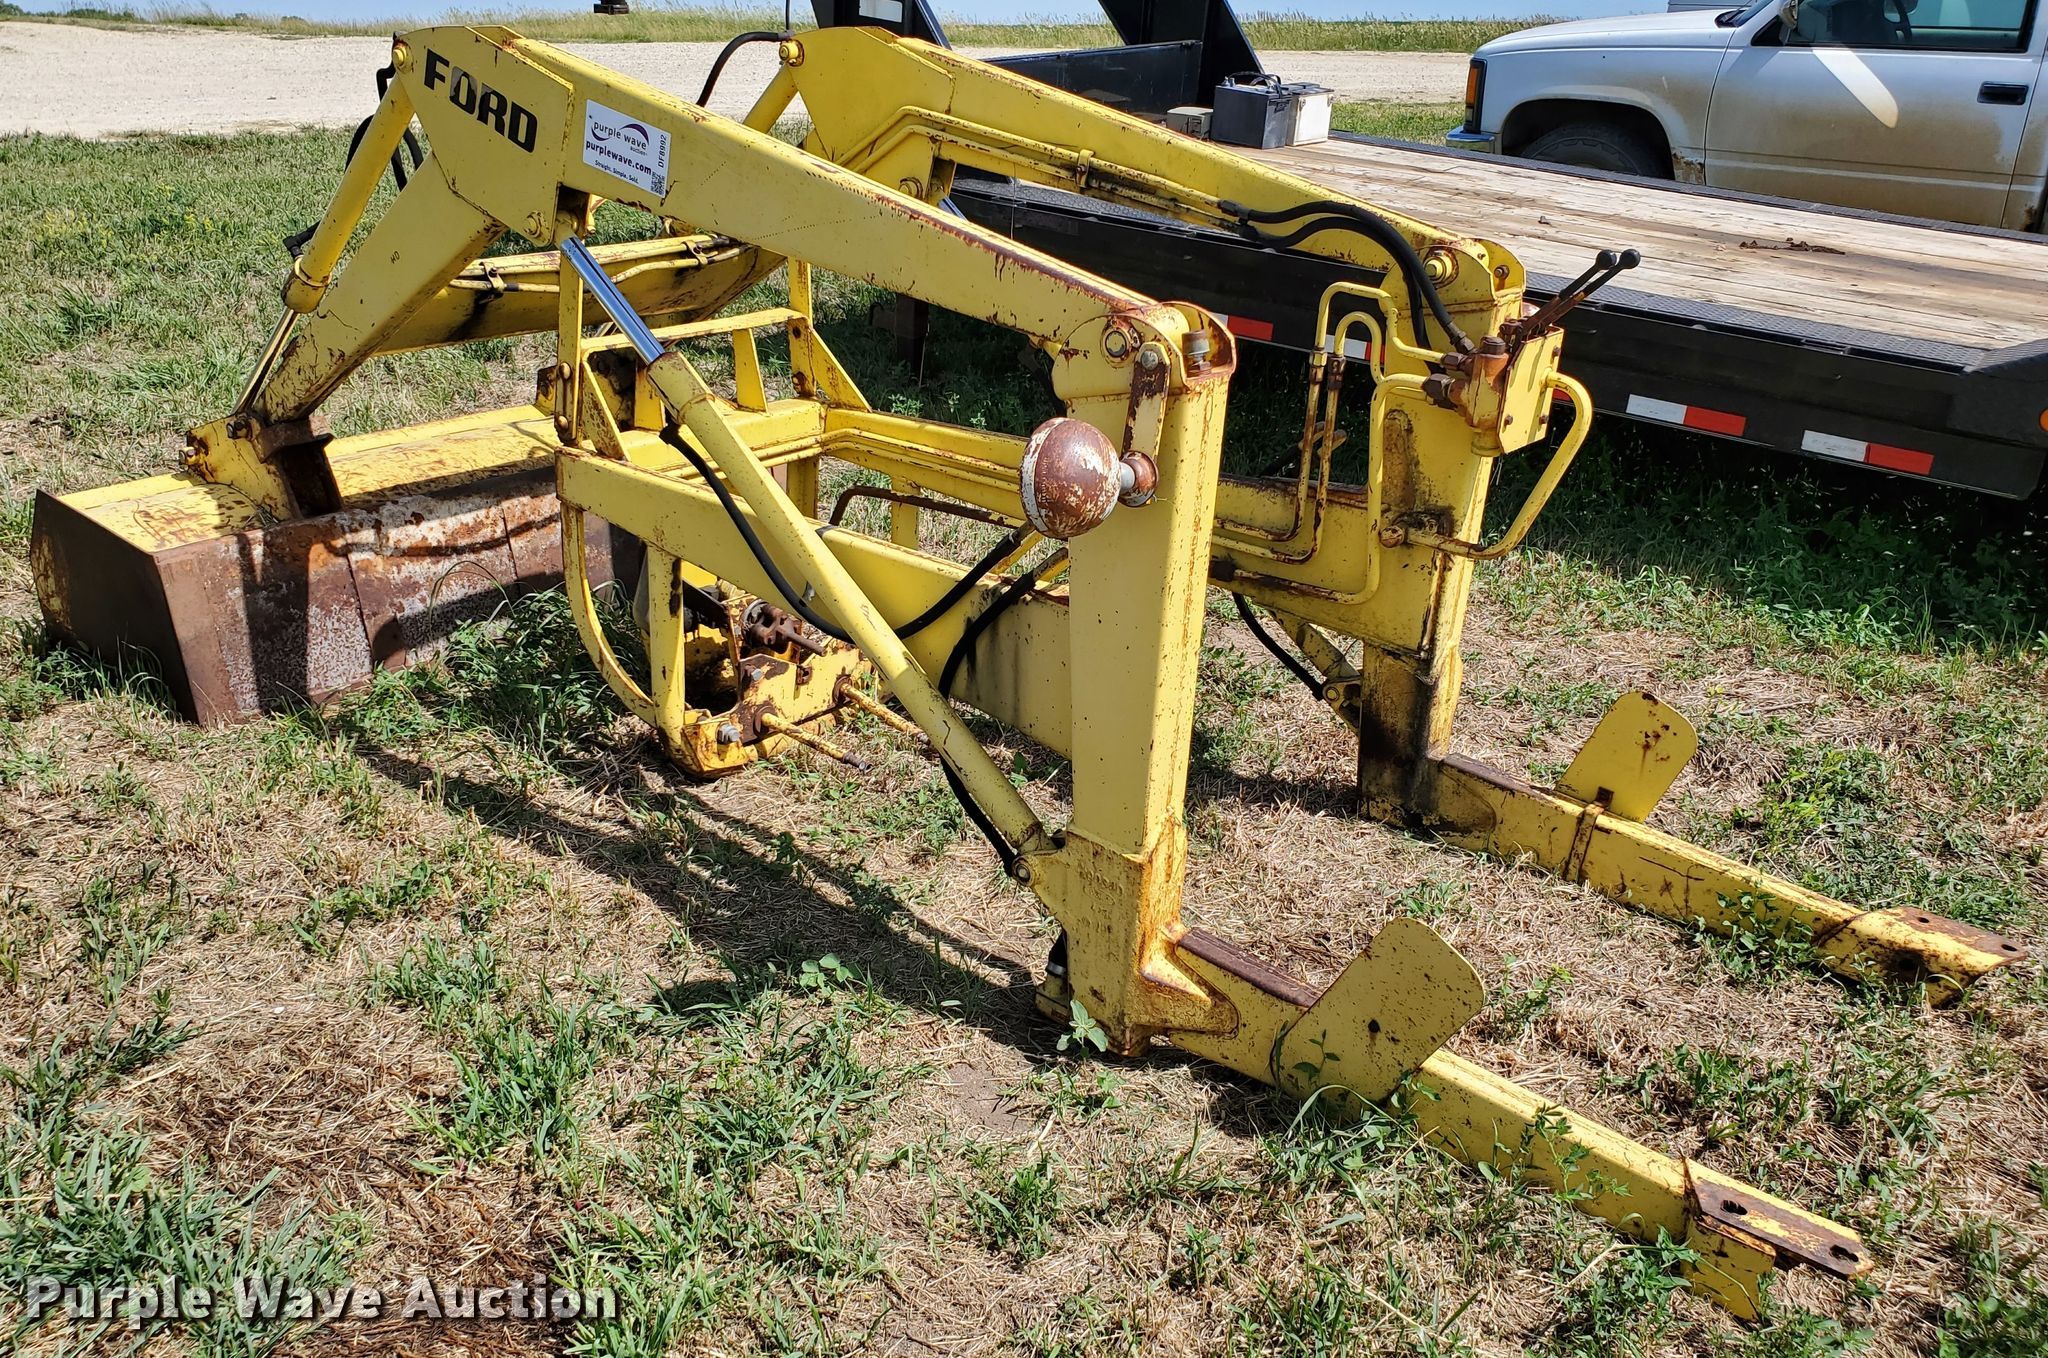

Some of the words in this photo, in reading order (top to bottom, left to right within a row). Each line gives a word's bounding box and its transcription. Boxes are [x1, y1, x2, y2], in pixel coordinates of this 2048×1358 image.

[424, 48, 538, 153] FORD
[593, 121, 621, 139] purple
[624, 134, 647, 150] wave
[657, 134, 667, 168] DF8992
[586, 140, 652, 175] purplewave.com
